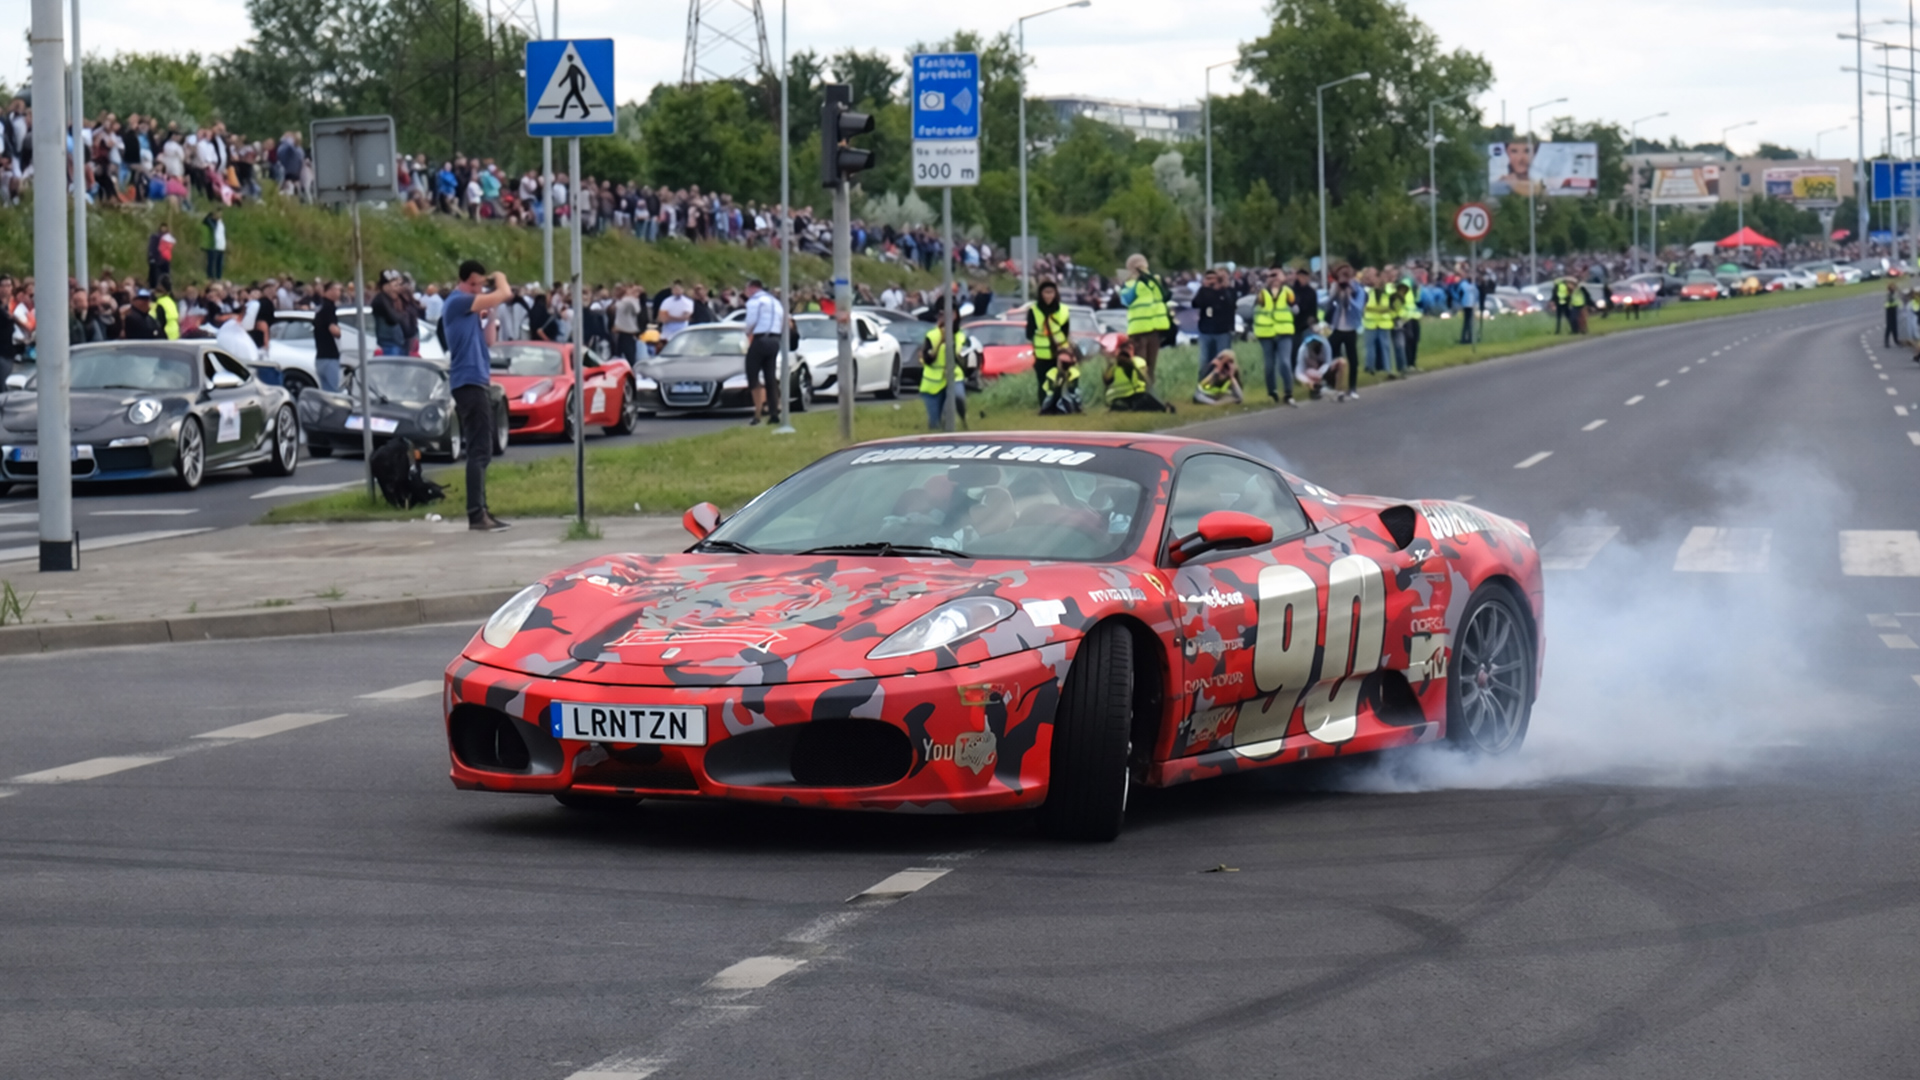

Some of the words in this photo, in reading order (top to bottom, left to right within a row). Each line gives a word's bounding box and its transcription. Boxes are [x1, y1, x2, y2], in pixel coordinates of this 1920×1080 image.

[917, 163, 952, 180] 300
[960, 168, 975, 179] m
[1463, 212, 1486, 232] 70
[1233, 553, 1386, 760] 90
[573, 707, 688, 740] LRNTZN
